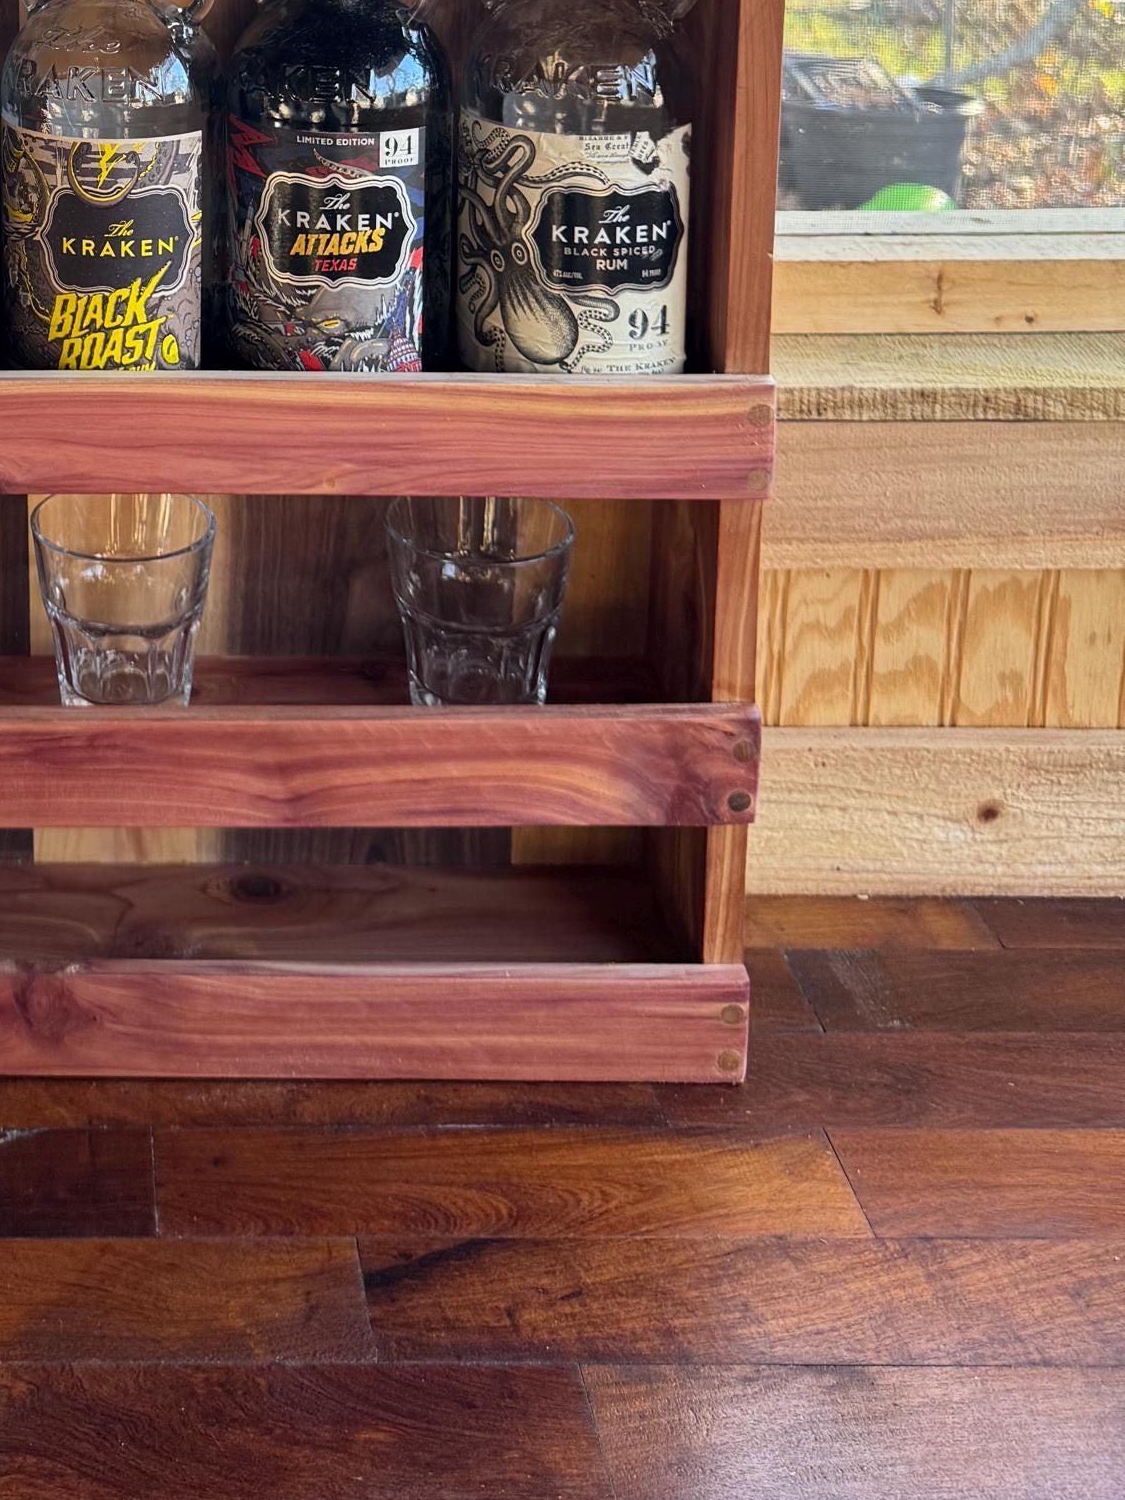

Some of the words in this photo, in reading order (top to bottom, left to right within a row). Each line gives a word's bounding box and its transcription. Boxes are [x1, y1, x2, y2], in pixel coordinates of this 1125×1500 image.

[296, 135, 334, 146] LIMITED
[335, 137, 375, 146] EDITION
[384, 134, 413, 157] 94
[584, 142, 601, 151] Sea
[384, 157, 415, 166] PROOF
[319, 192, 351, 211] The
[277, 208, 393, 232] KRAKEN
[598, 204, 631, 224] The
[104, 219, 135, 238] The
[551, 221, 668, 244] KRAKEN
[62, 236, 174, 258] KRAKEN
[289, 227, 385, 256] ATTACKS
[563, 246, 608, 257] BLACK
[613, 245, 656, 257] SPICED
[314, 258, 357, 272] TEXAS
[596, 259, 629, 271] RUM
[48, 260, 173, 342] BLACK
[628, 304, 670, 341] 94
[58, 313, 170, 371] ROAST
[606, 364, 632, 373] THE
[635, 356, 676, 371] KRAKEN
